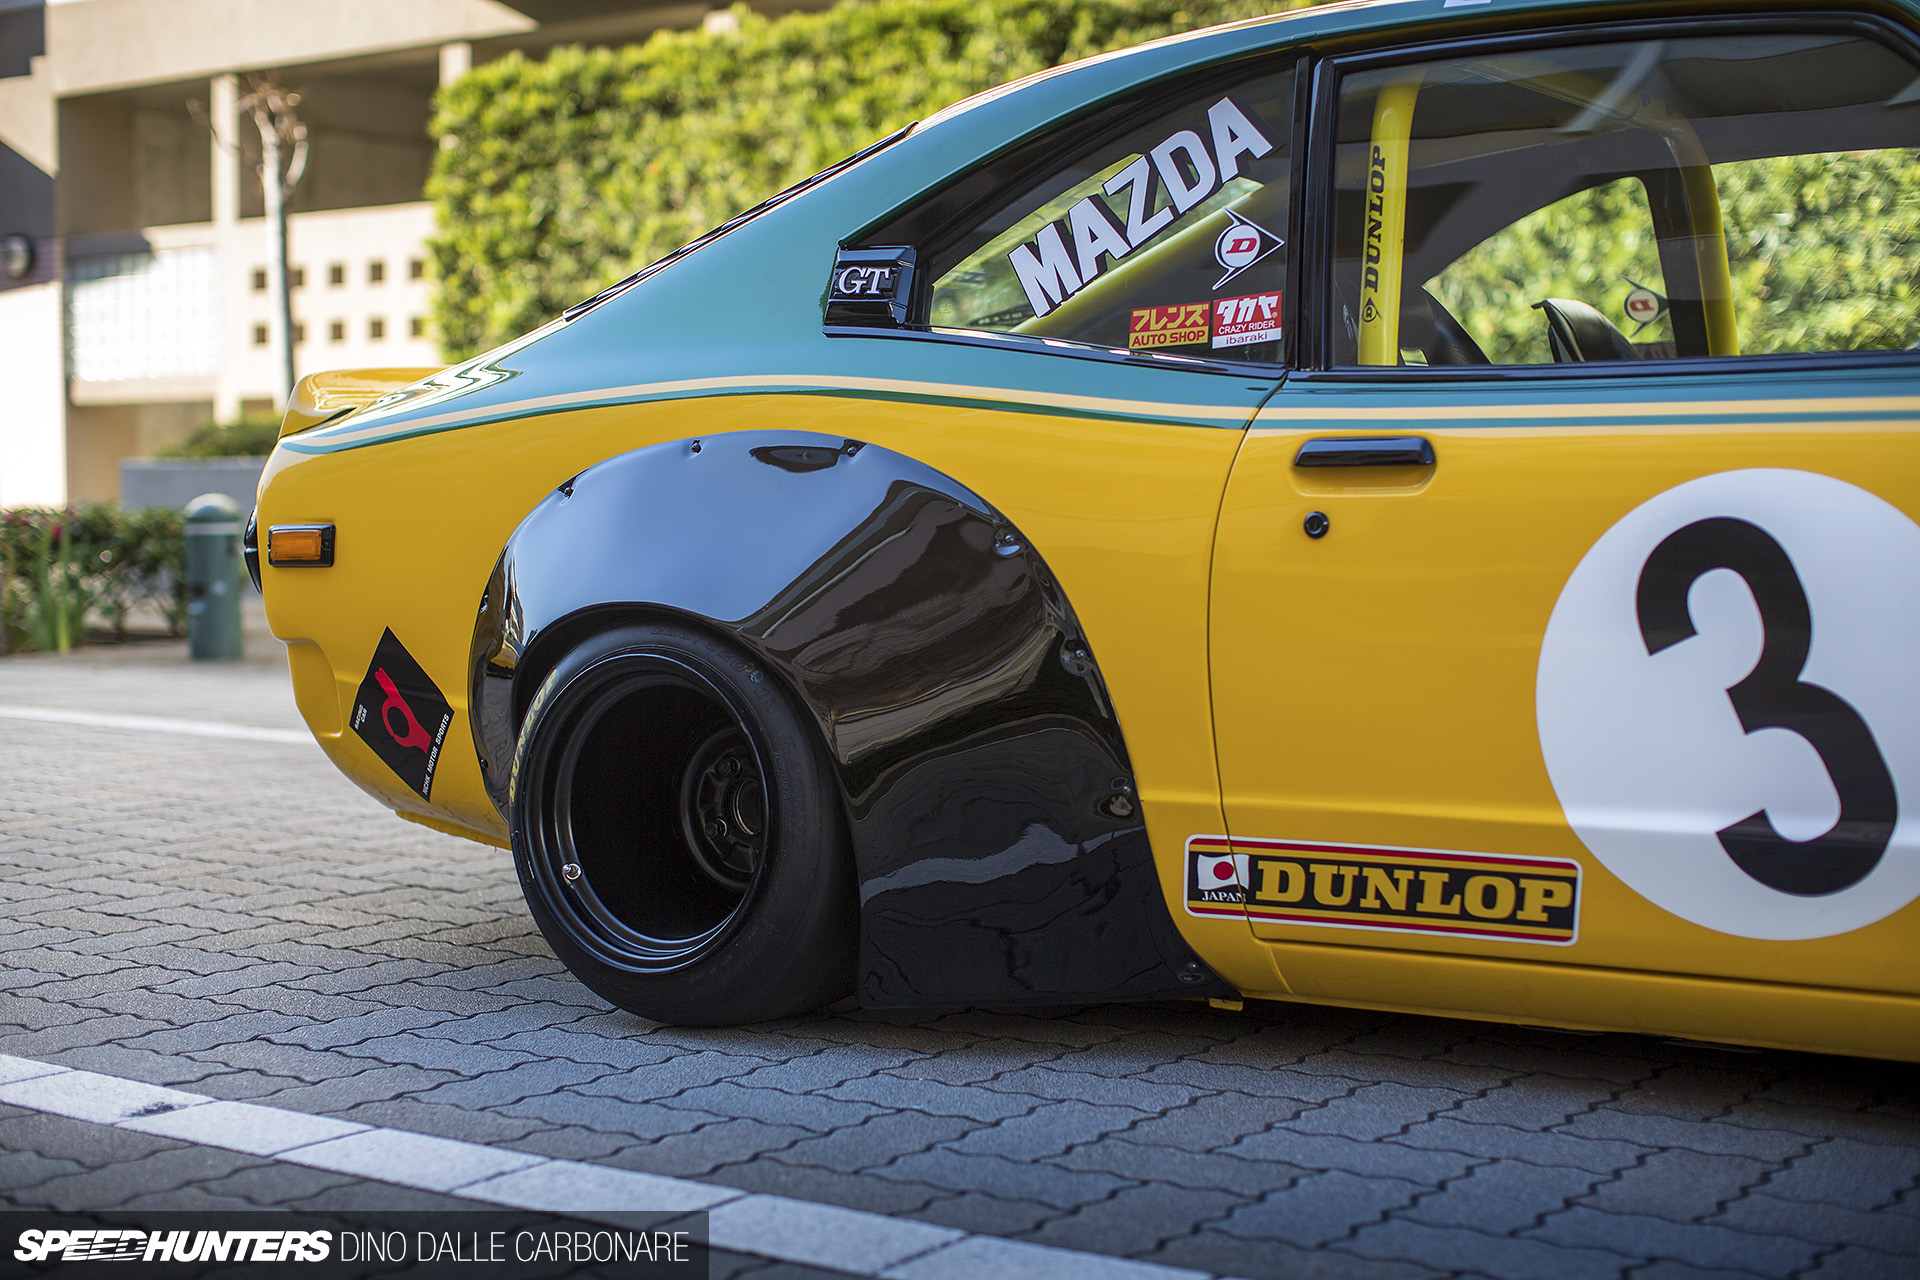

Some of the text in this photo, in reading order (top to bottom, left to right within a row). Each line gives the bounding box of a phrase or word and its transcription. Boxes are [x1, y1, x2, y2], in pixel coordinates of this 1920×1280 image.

[1007, 96, 1273, 319] MAZDA
[1364, 145, 1386, 293] DUNLOP
[838, 266, 890, 295] GT
[1132, 303, 1209, 332] フレンズ
[1216, 295, 1279, 325] タカヤ
[1131, 330, 1206, 347] AUTO SHOP
[1218, 319, 1275, 335] CRAZY RIDER
[1225, 331, 1268, 345] ibaraki
[1636, 515, 1898, 898] 3
[427, 745, 439, 774] MOTOR
[435, 713, 450, 746] SPORTS
[509, 667, 557, 804] DUNLOP
[1201, 889, 1247, 903] JAPAN
[1255, 859, 1573, 923] DUNLOP
